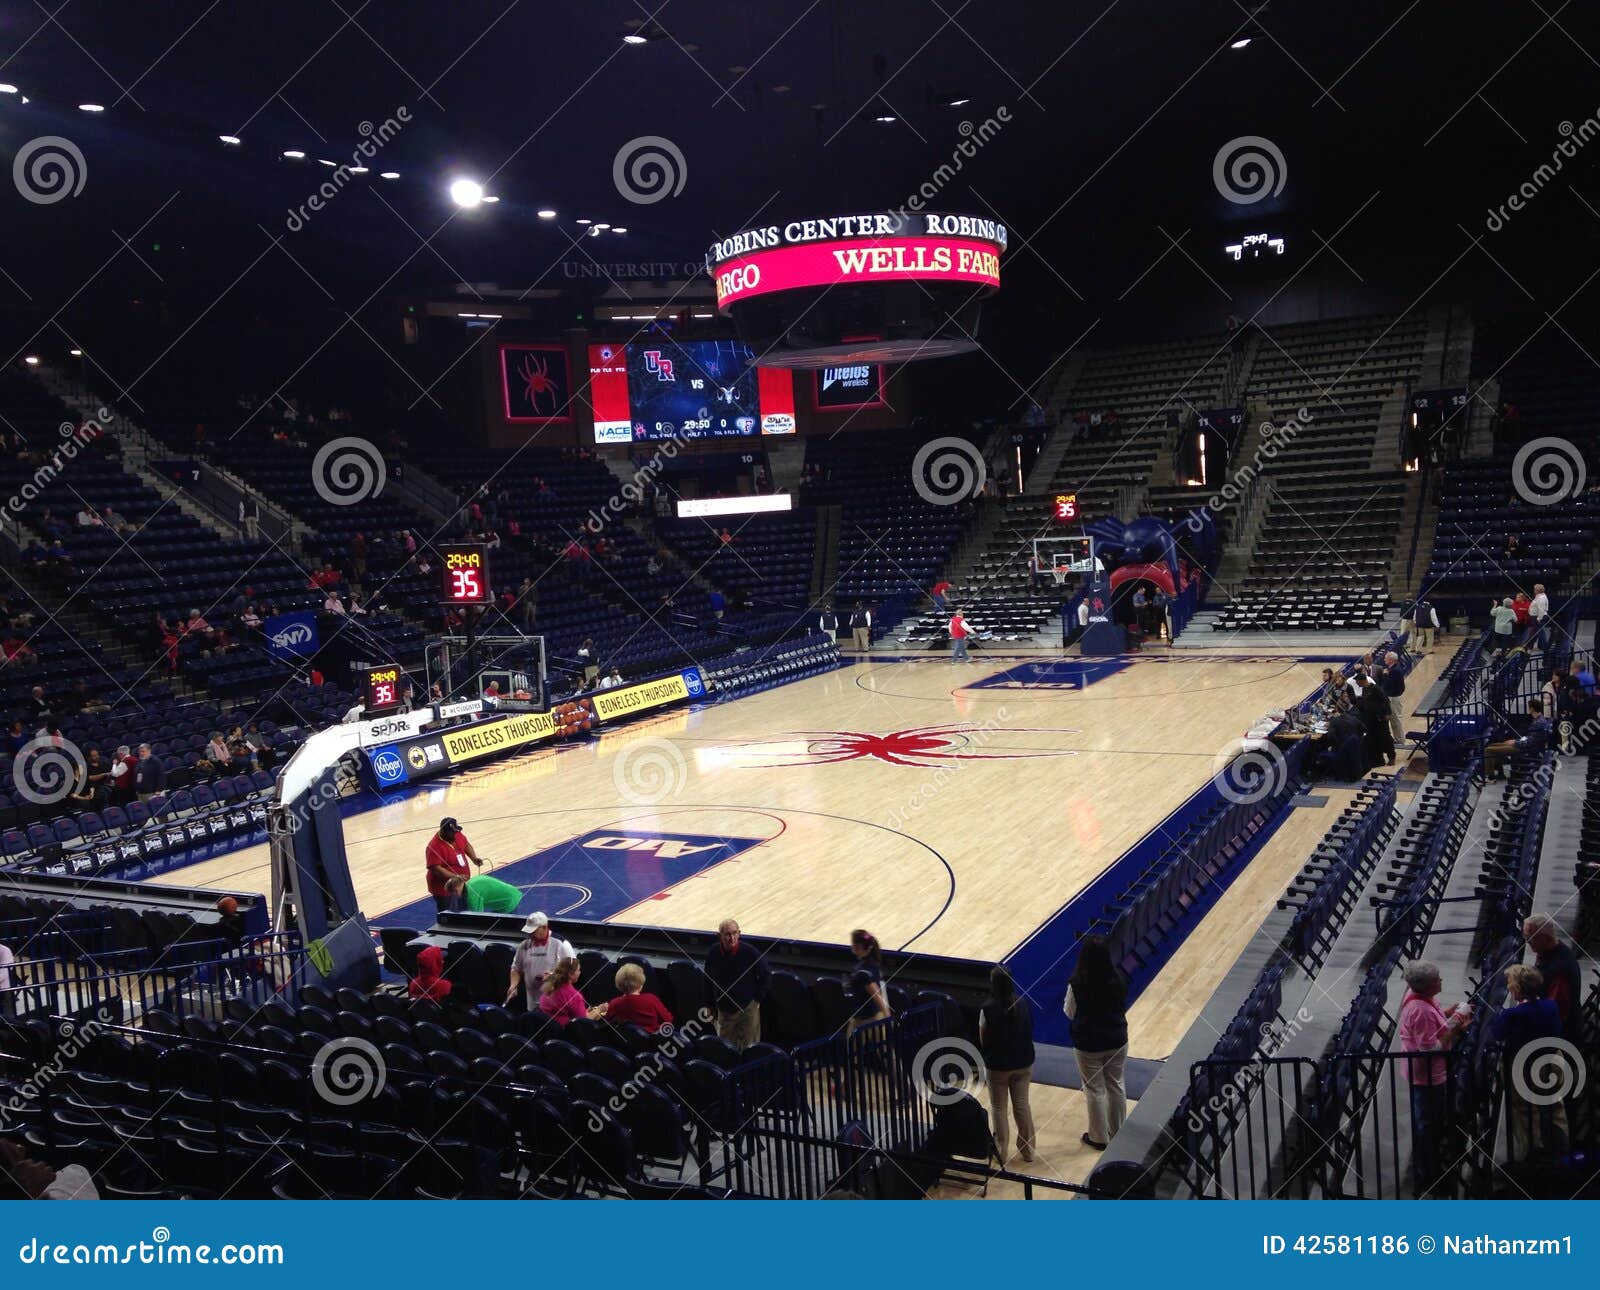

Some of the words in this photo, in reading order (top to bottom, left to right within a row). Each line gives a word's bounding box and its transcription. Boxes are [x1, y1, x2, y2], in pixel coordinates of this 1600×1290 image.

[926, 214, 995, 239] ROBINS
[715, 226, 779, 261] ROBINS
[785, 214, 894, 242] CENTER
[833, 247, 951, 274] WELLS
[606, 426, 631, 435] ACE
[684, 419, 710, 429] 29:50
[741, 455, 753, 463] 10
[192, 470, 199, 481] 7
[1059, 503, 1074, 517] 35
[447, 553, 480, 569] 29:49
[452, 570, 478, 597] 35
[376, 685, 392, 704] 35
[600, 691, 640, 714] BONELESS
[640, 680, 682, 703] THURSDAYS
[450, 728, 504, 756] BONELESS
[504, 714, 554, 741] THURSDAY
[376, 756, 401, 777] Kroger
